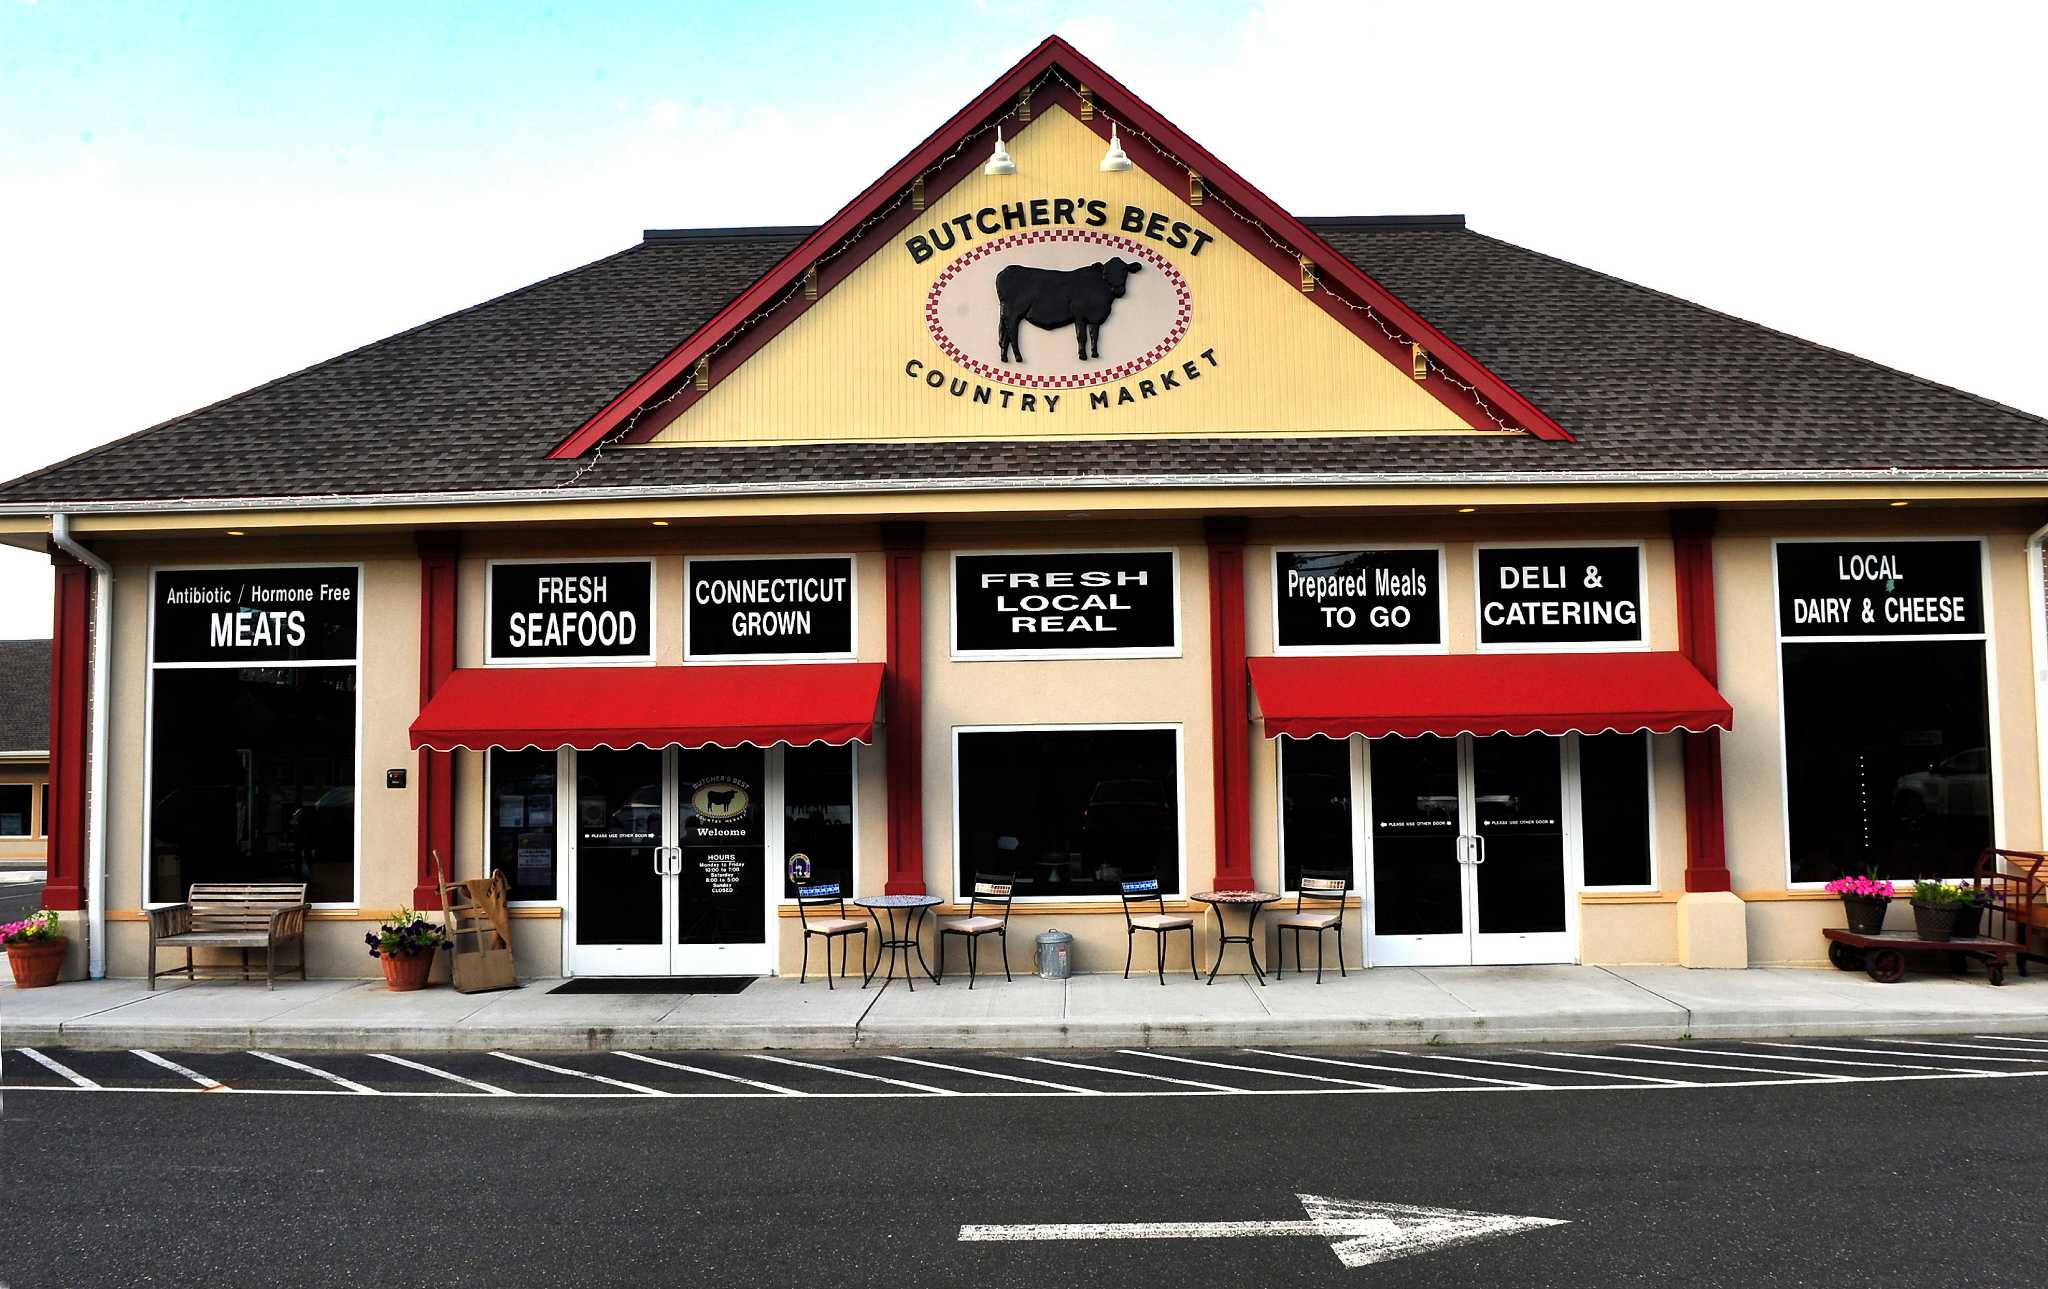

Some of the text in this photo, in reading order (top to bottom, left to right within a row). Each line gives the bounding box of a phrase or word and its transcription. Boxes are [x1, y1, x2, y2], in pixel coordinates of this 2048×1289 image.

[905, 198, 1213, 264] BUTCHER'S BEST
[905, 348, 1218, 412] COUNTRY MARKET
[981, 571, 1148, 588] FRESH
[1500, 565, 1603, 589] DELI &
[1838, 554, 1903, 580] LOCAL
[167, 587, 231, 604] Antibiotic
[252, 584, 313, 602] Hormone
[320, 584, 350, 600] Free
[538, 576, 607, 604] FRESH
[695, 578, 846, 604] CONNECTICUT
[1288, 568, 1426, 603] Prepared Meals
[997, 594, 1131, 612] LOCAL
[1484, 601, 1636, 625] CATERING
[1794, 596, 1965, 623] DAIRY & CHEESE
[210, 610, 306, 647] MEATS
[509, 610, 637, 647] SEAFOOD
[732, 611, 811, 636] GROWN
[1012, 616, 1117, 632] REAL
[1321, 605, 1411, 628] TO GO
[697, 828, 746, 836] Welcome
